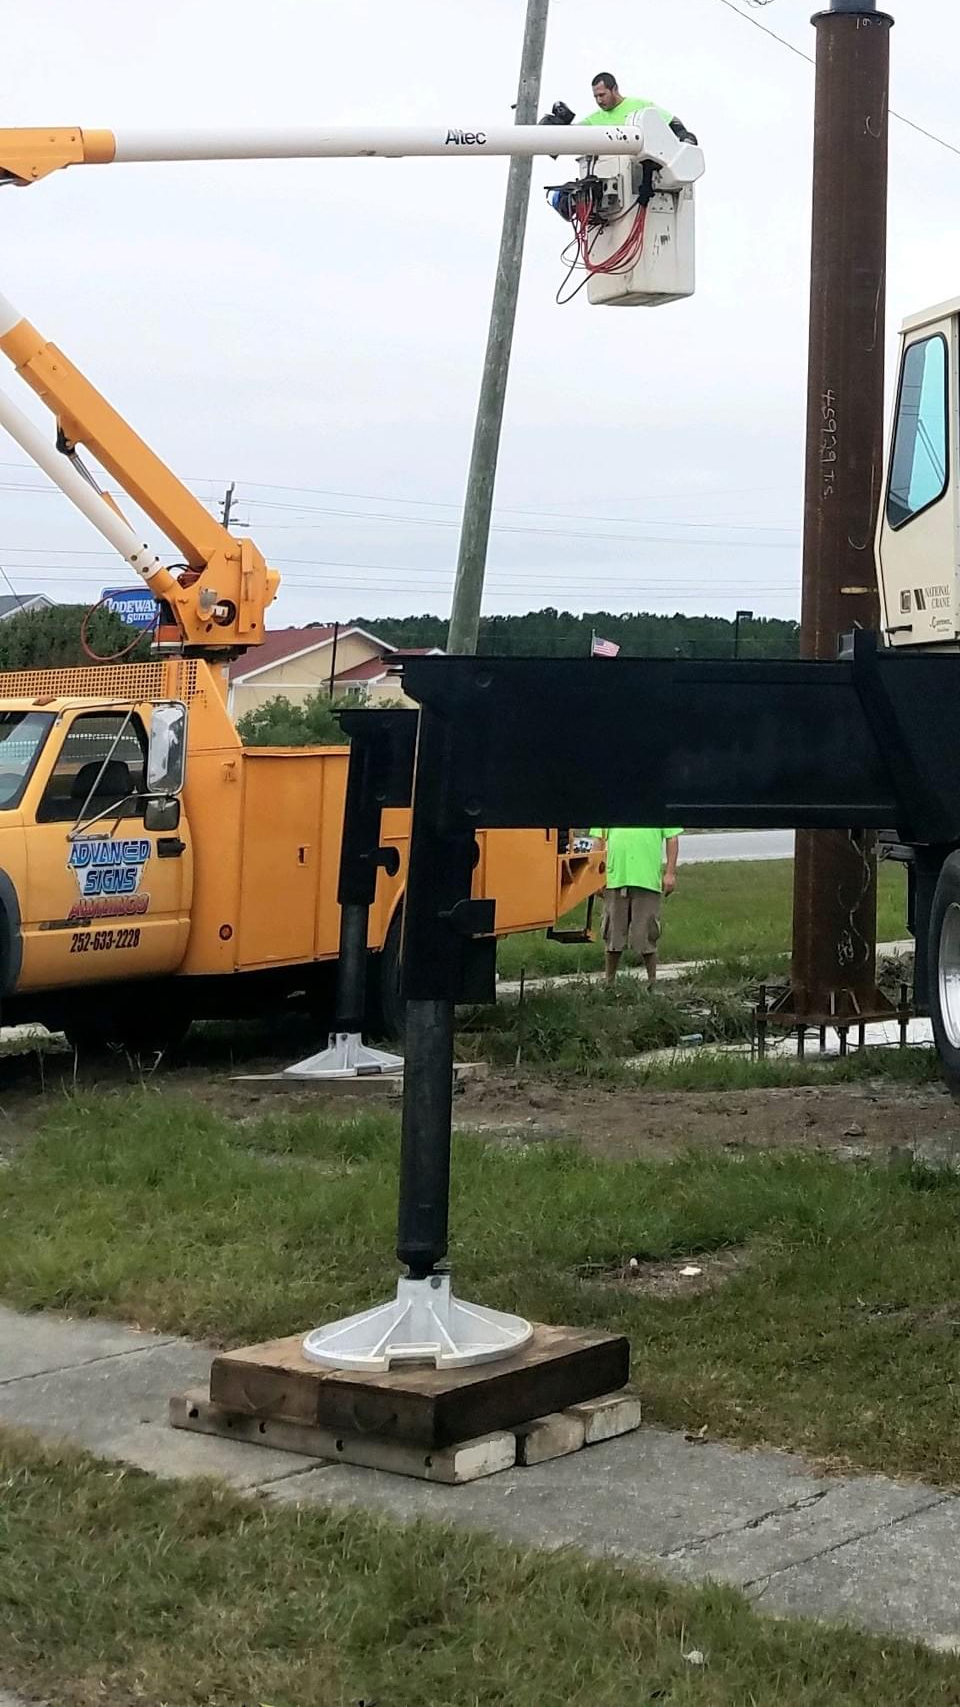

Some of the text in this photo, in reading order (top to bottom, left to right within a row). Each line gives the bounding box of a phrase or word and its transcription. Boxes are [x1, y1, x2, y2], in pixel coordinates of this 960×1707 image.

[445, 128, 487, 145] Altec
[931, 597, 951, 609] CRANE
[69, 840, 151, 868] ADVANCED
[83, 868, 138, 896] SIGNS
[70, 928, 141, 953] 252-633-2228
